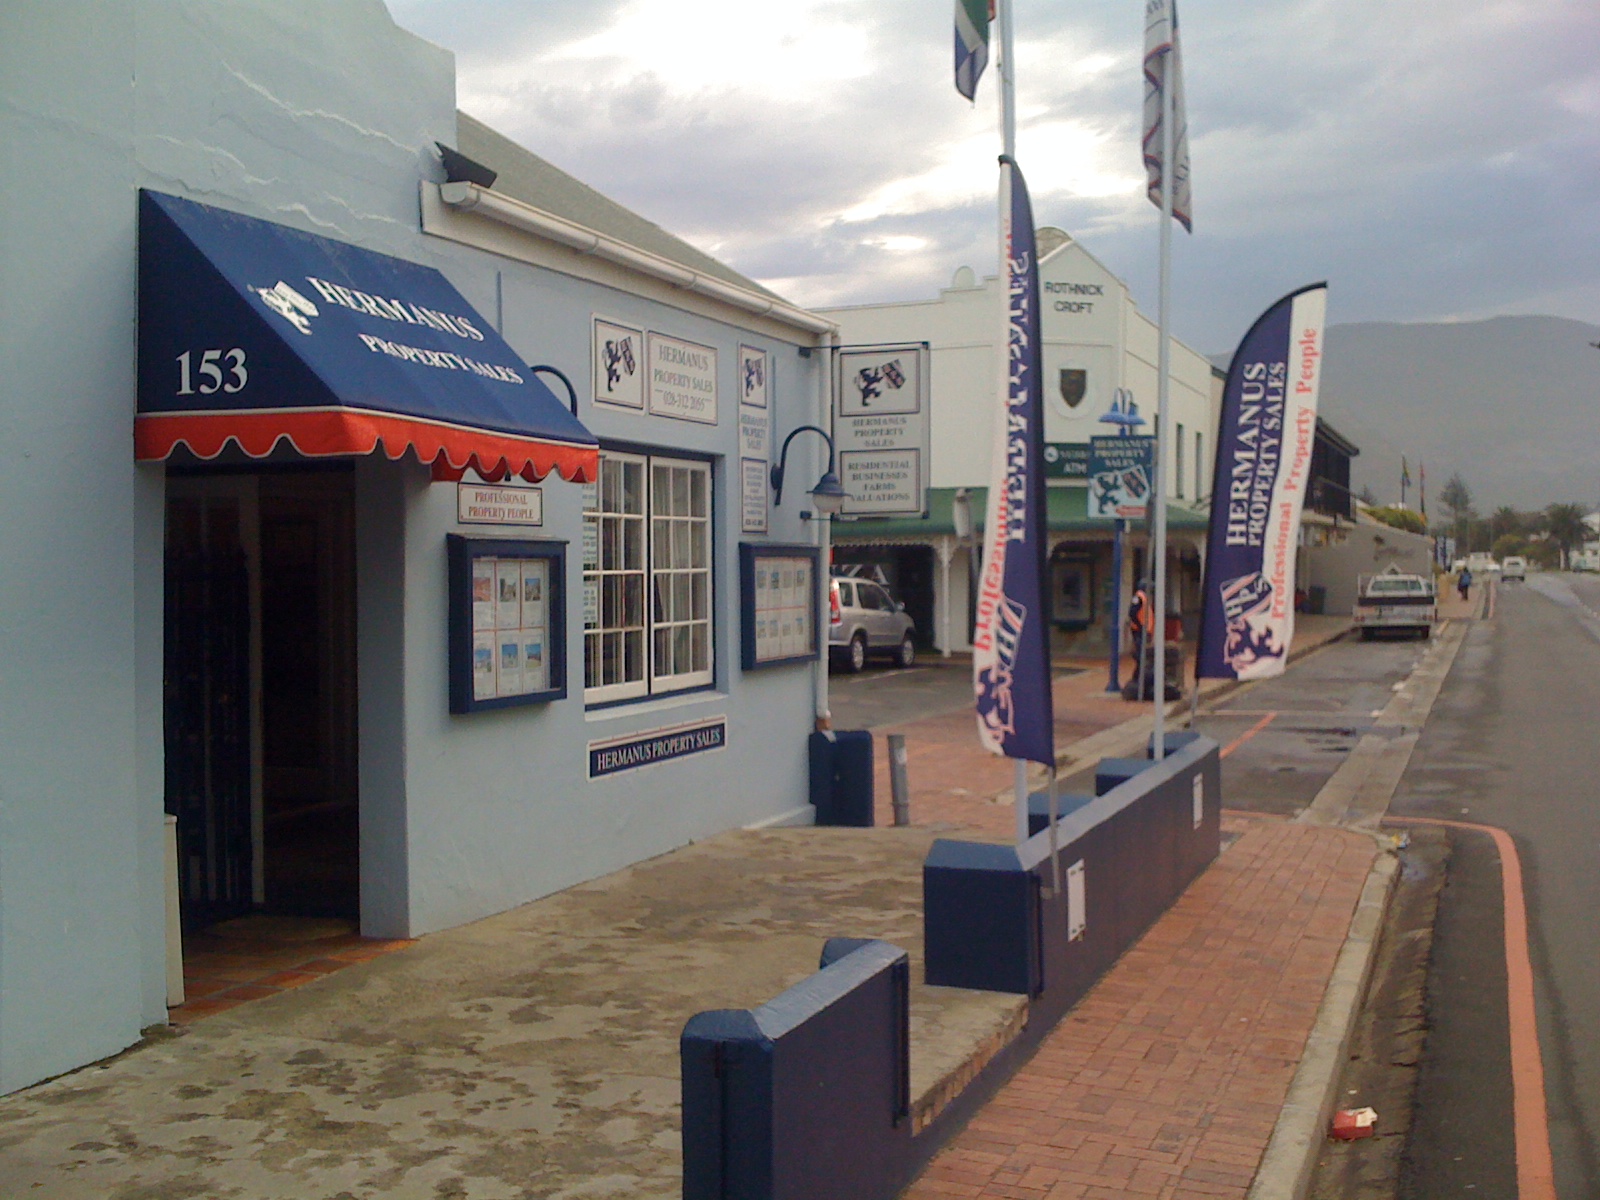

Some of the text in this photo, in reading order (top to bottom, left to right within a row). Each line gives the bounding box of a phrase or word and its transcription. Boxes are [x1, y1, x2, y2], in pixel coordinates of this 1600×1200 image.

[1044, 281, 1104, 296] ROTHNICK
[305, 276, 485, 342] HERMANUS
[1054, 300, 1094, 313] CROFT
[358, 333, 524, 385] PROPERTY SALES
[659, 345, 709, 371] HERMANUS
[176, 347, 248, 396] 153
[654, 368, 714, 393] PROPERTY SALES
[852, 417, 907, 426] HERMANUS
[855, 428, 904, 437] PROPERTY
[864, 439, 895, 447] SALES
[1226, 362, 1267, 547] HERMANUS
[1248, 361, 1286, 548] PROPERTY SALES
[848, 461, 911, 470] RESIDENTIAL
[852, 472, 909, 480] BUSINESSES
[1271, 328, 1317, 618] Professional Property People
[864, 482, 897, 491] FARMS
[475, 492, 528, 505] PROFESSIONAL
[851, 493, 911, 501] VALUATIONS
[469, 506, 534, 520] PROPERTY PEOPLE
[597, 728, 720, 771] HERMANUS PROPERTY SALES
